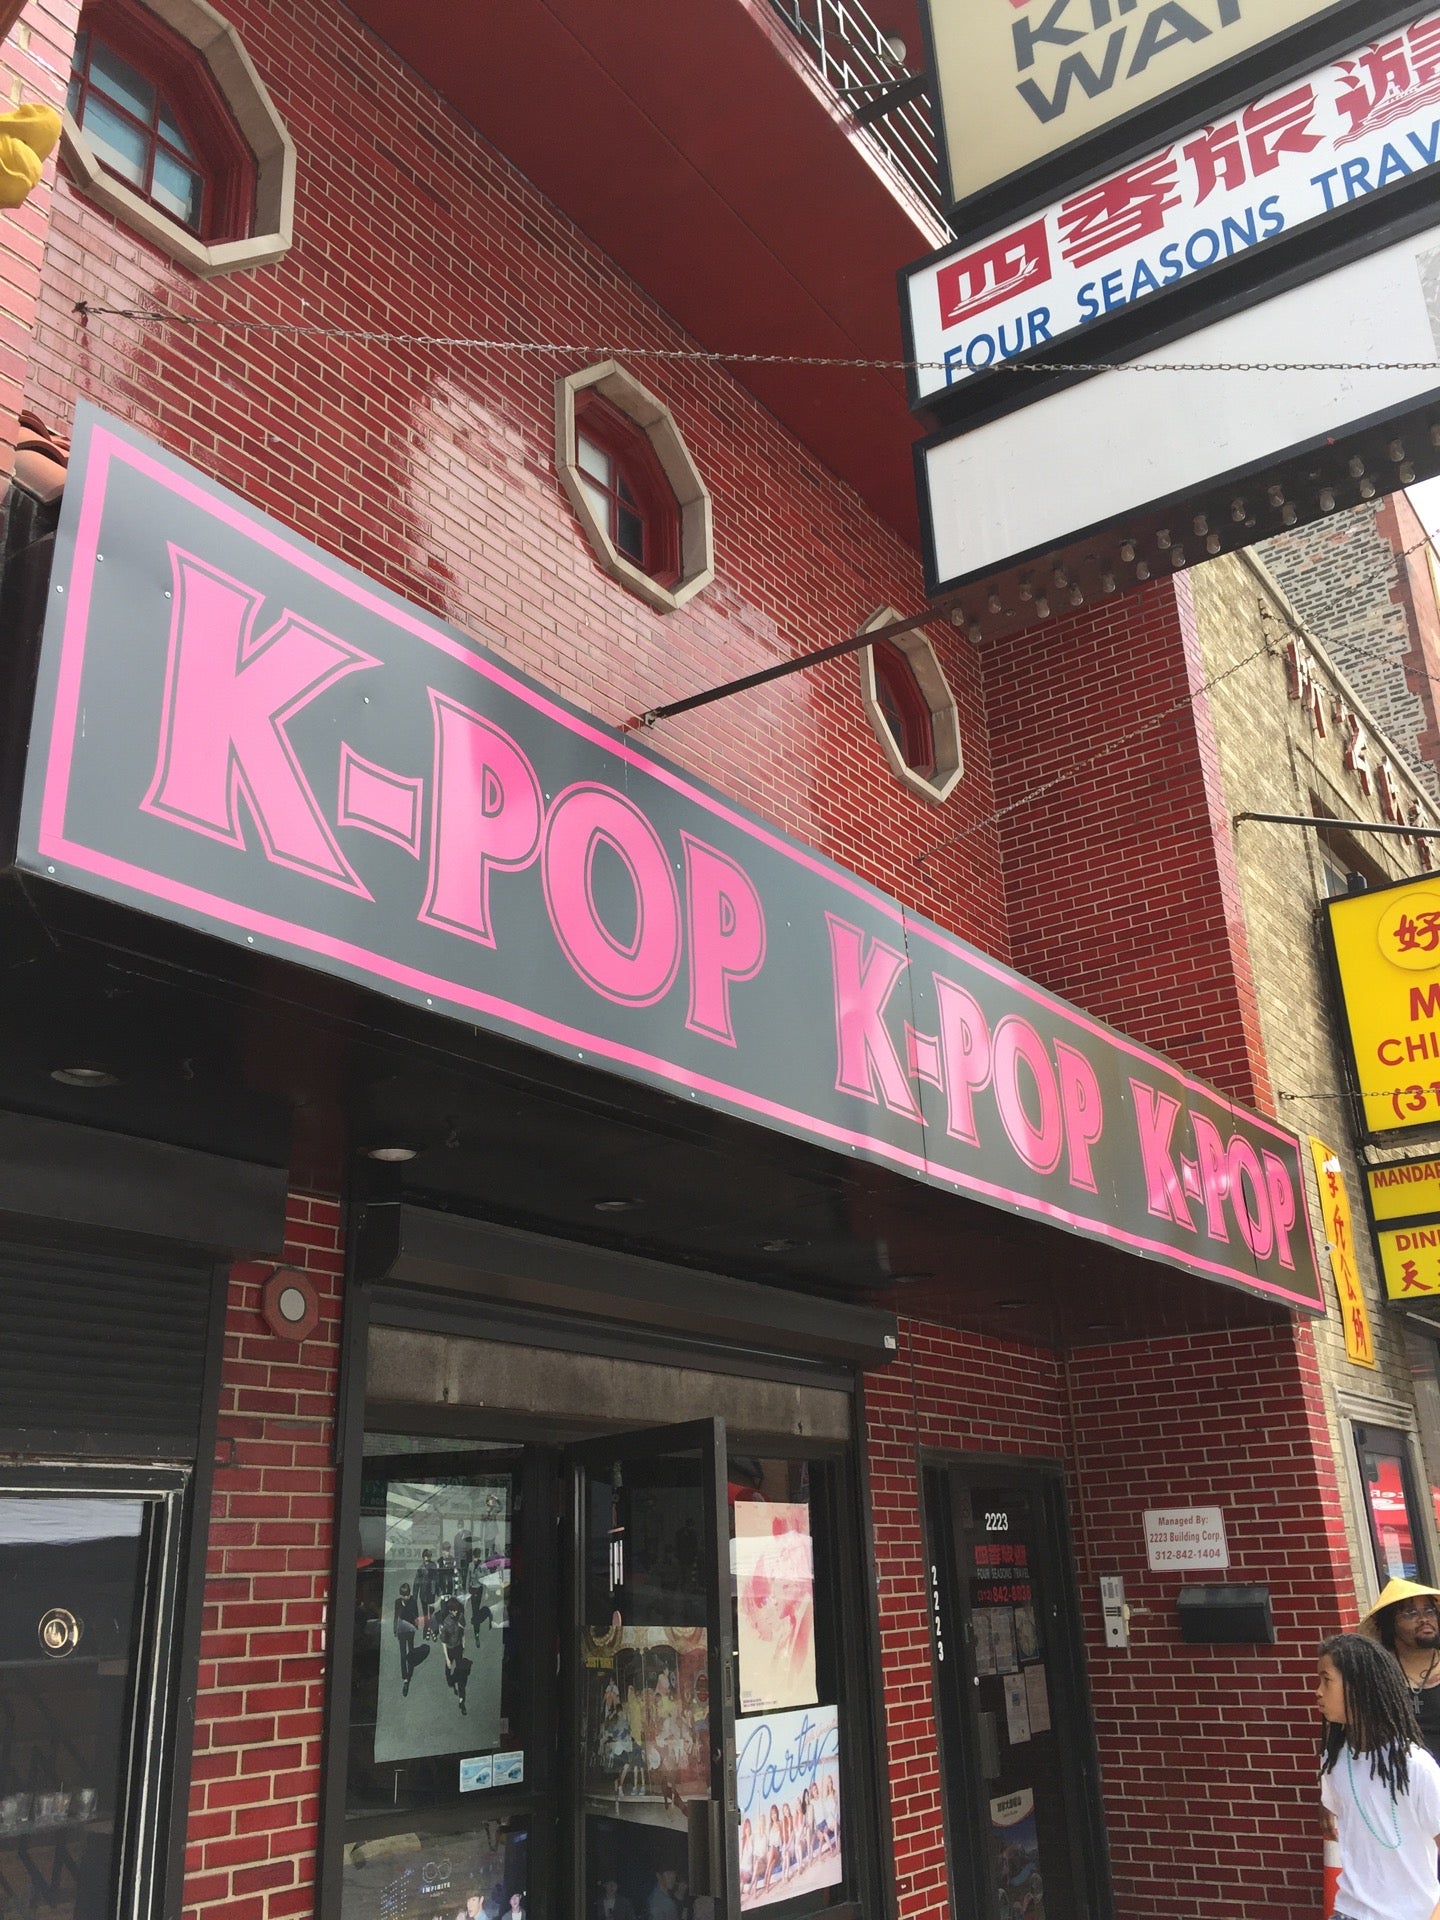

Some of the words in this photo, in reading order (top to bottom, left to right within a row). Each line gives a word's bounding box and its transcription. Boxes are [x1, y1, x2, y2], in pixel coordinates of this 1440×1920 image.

[943, 306, 1053, 386] FOUR
[1076, 195, 1286, 323] SEASONS
[139, 541, 767, 1048] K-POP
[824, 910, 1104, 1194] K-POP
[1129, 1077, 1296, 1271] K-POP
[984, 1512, 1009, 1531] 2223
[1158, 1515, 1194, 1527] Managed
[1196, 1515, 1209, 1526] By:
[1149, 1533, 1168, 1543] 2223
[1169, 1532, 1200, 1544] Building
[1202, 1530, 1223, 1543] Corp.
[1155, 1548, 1221, 1561] 312-842-1404
[976, 1567, 990, 1580] FOUR
[931, 1565, 945, 1662] 2223
[736, 1713, 838, 1814] Party
